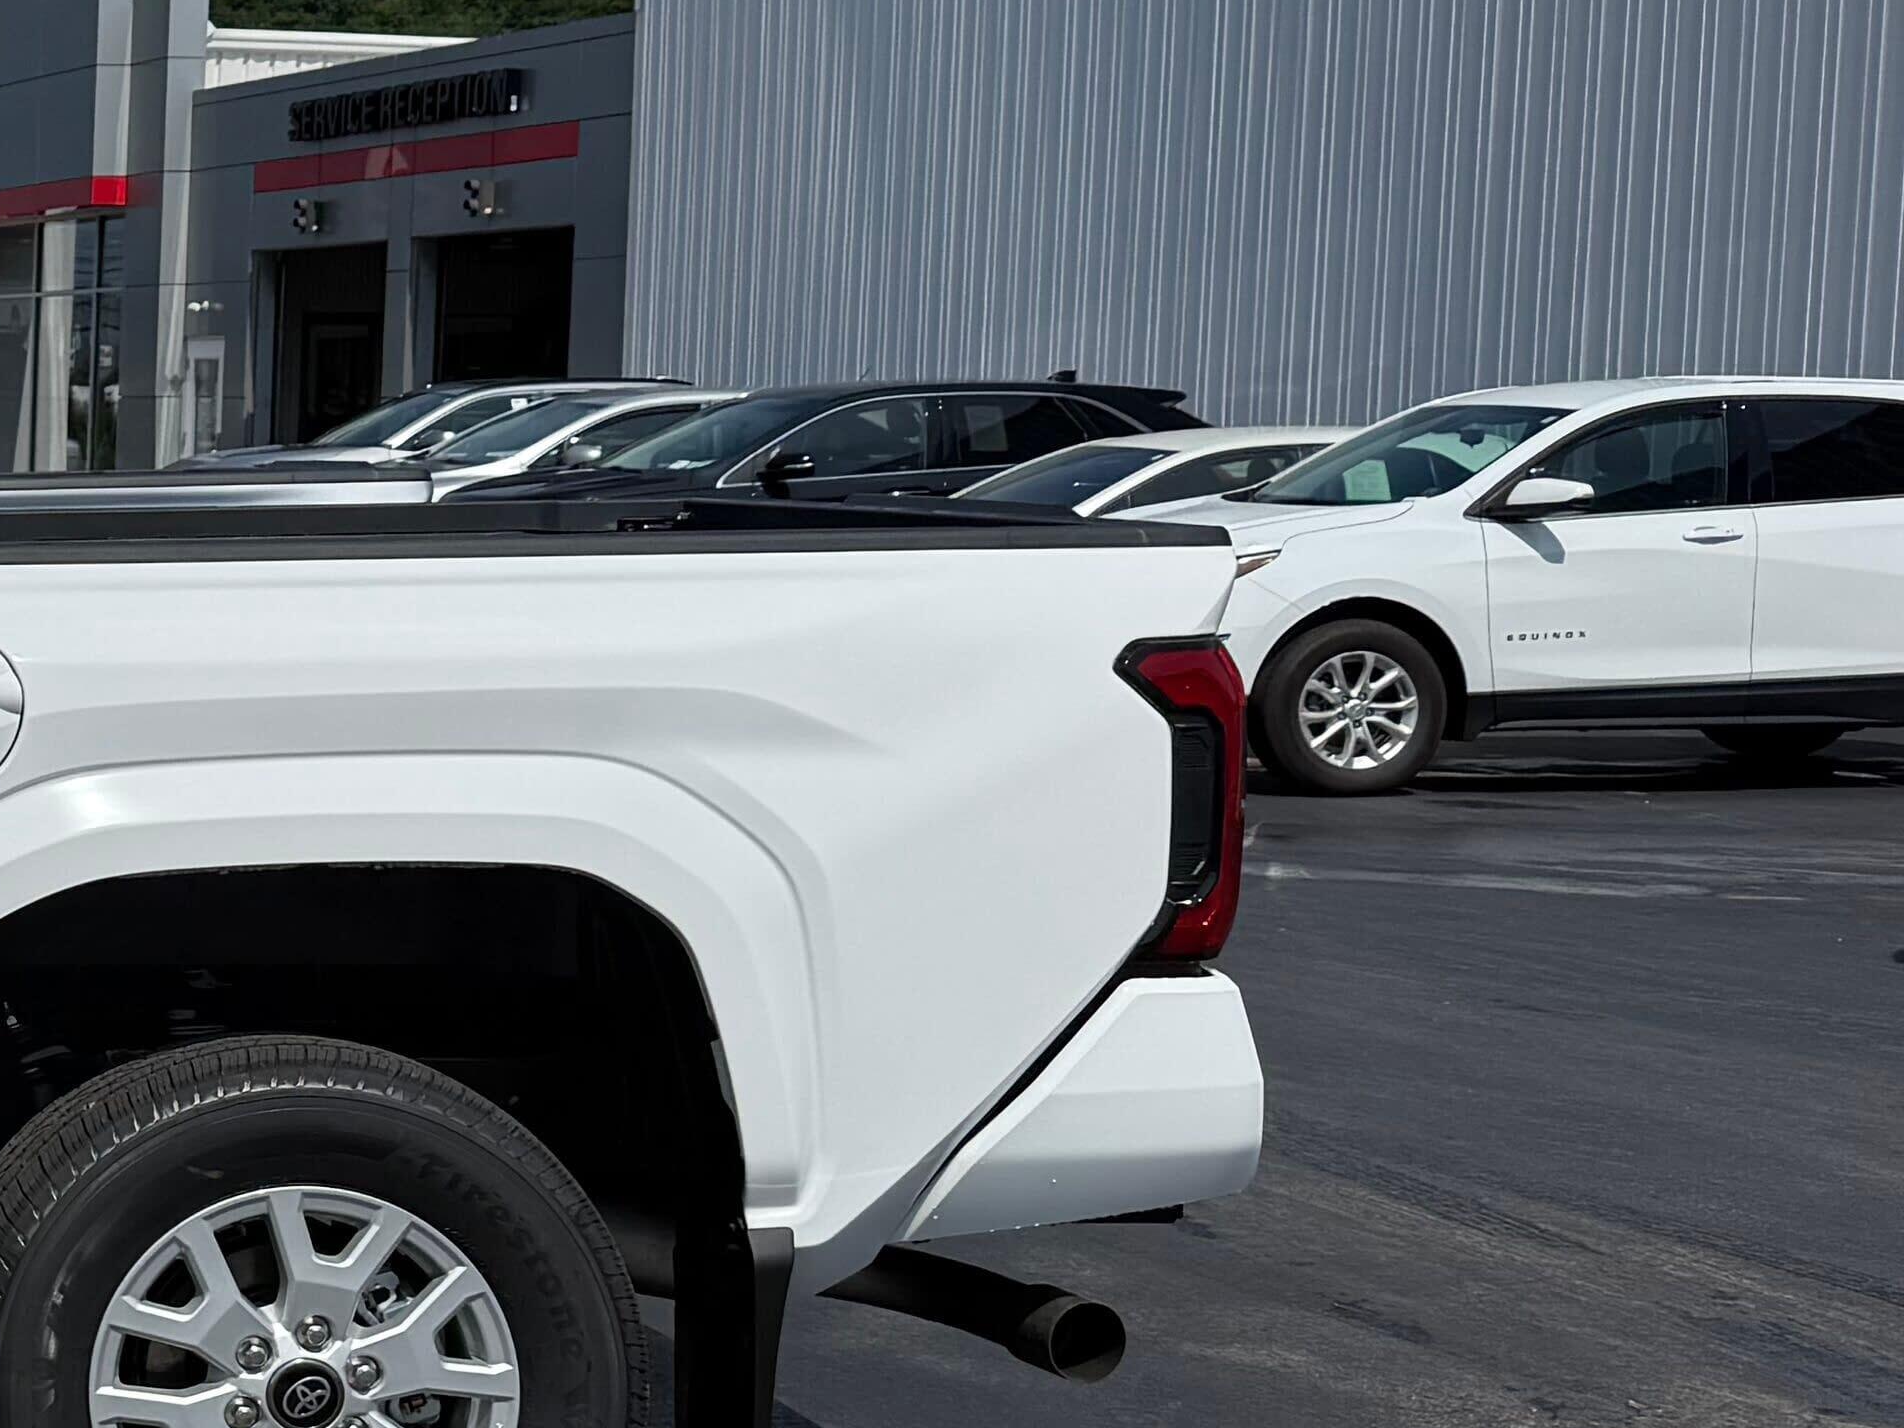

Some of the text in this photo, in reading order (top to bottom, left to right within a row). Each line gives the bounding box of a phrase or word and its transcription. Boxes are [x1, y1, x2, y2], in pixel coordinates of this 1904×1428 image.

[288, 68, 518, 141] SERVICE RECEPTION
[1506, 631, 1587, 642] EQUINOX
